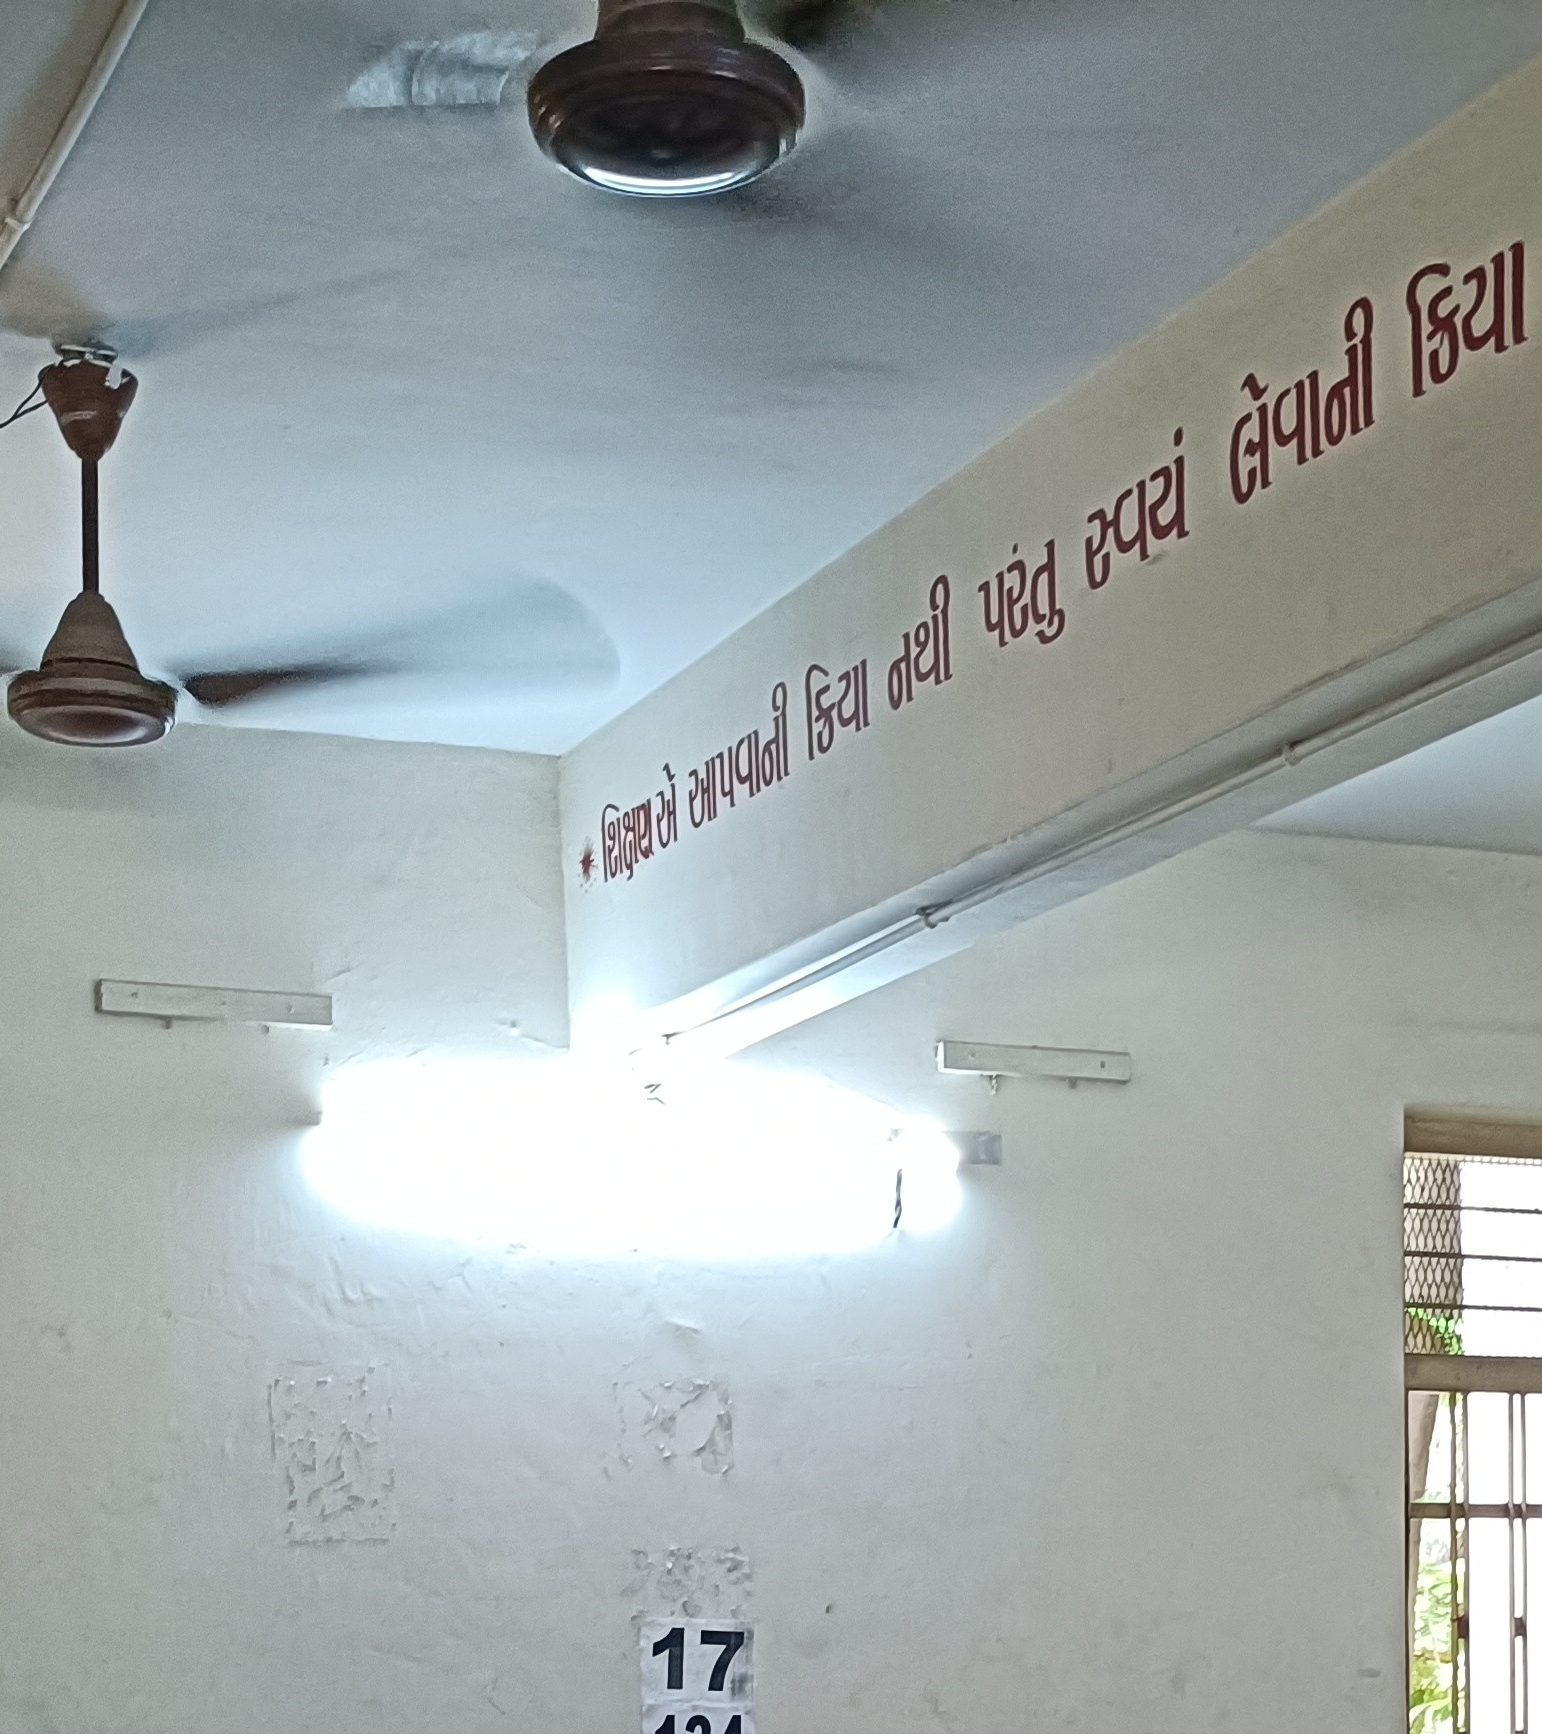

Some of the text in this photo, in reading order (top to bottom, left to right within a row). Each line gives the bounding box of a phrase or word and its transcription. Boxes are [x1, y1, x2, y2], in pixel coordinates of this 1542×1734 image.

[601, 803, 655, 882] શિક્ષણ
[656, 762, 678, 849] એ
[688, 681, 790, 828] આપવાની
[805, 658, 870, 761] ક્રિયા
[887, 574, 954, 711] નથી
[977, 539, 1066, 648] પરંતુ
[1085, 426, 1190, 590] સ્વયં
[1229, 296, 1375, 505] લેવાની
[1405, 240, 1529, 398] ક્રિયા
[652, 1627, 745, 1691] 17
